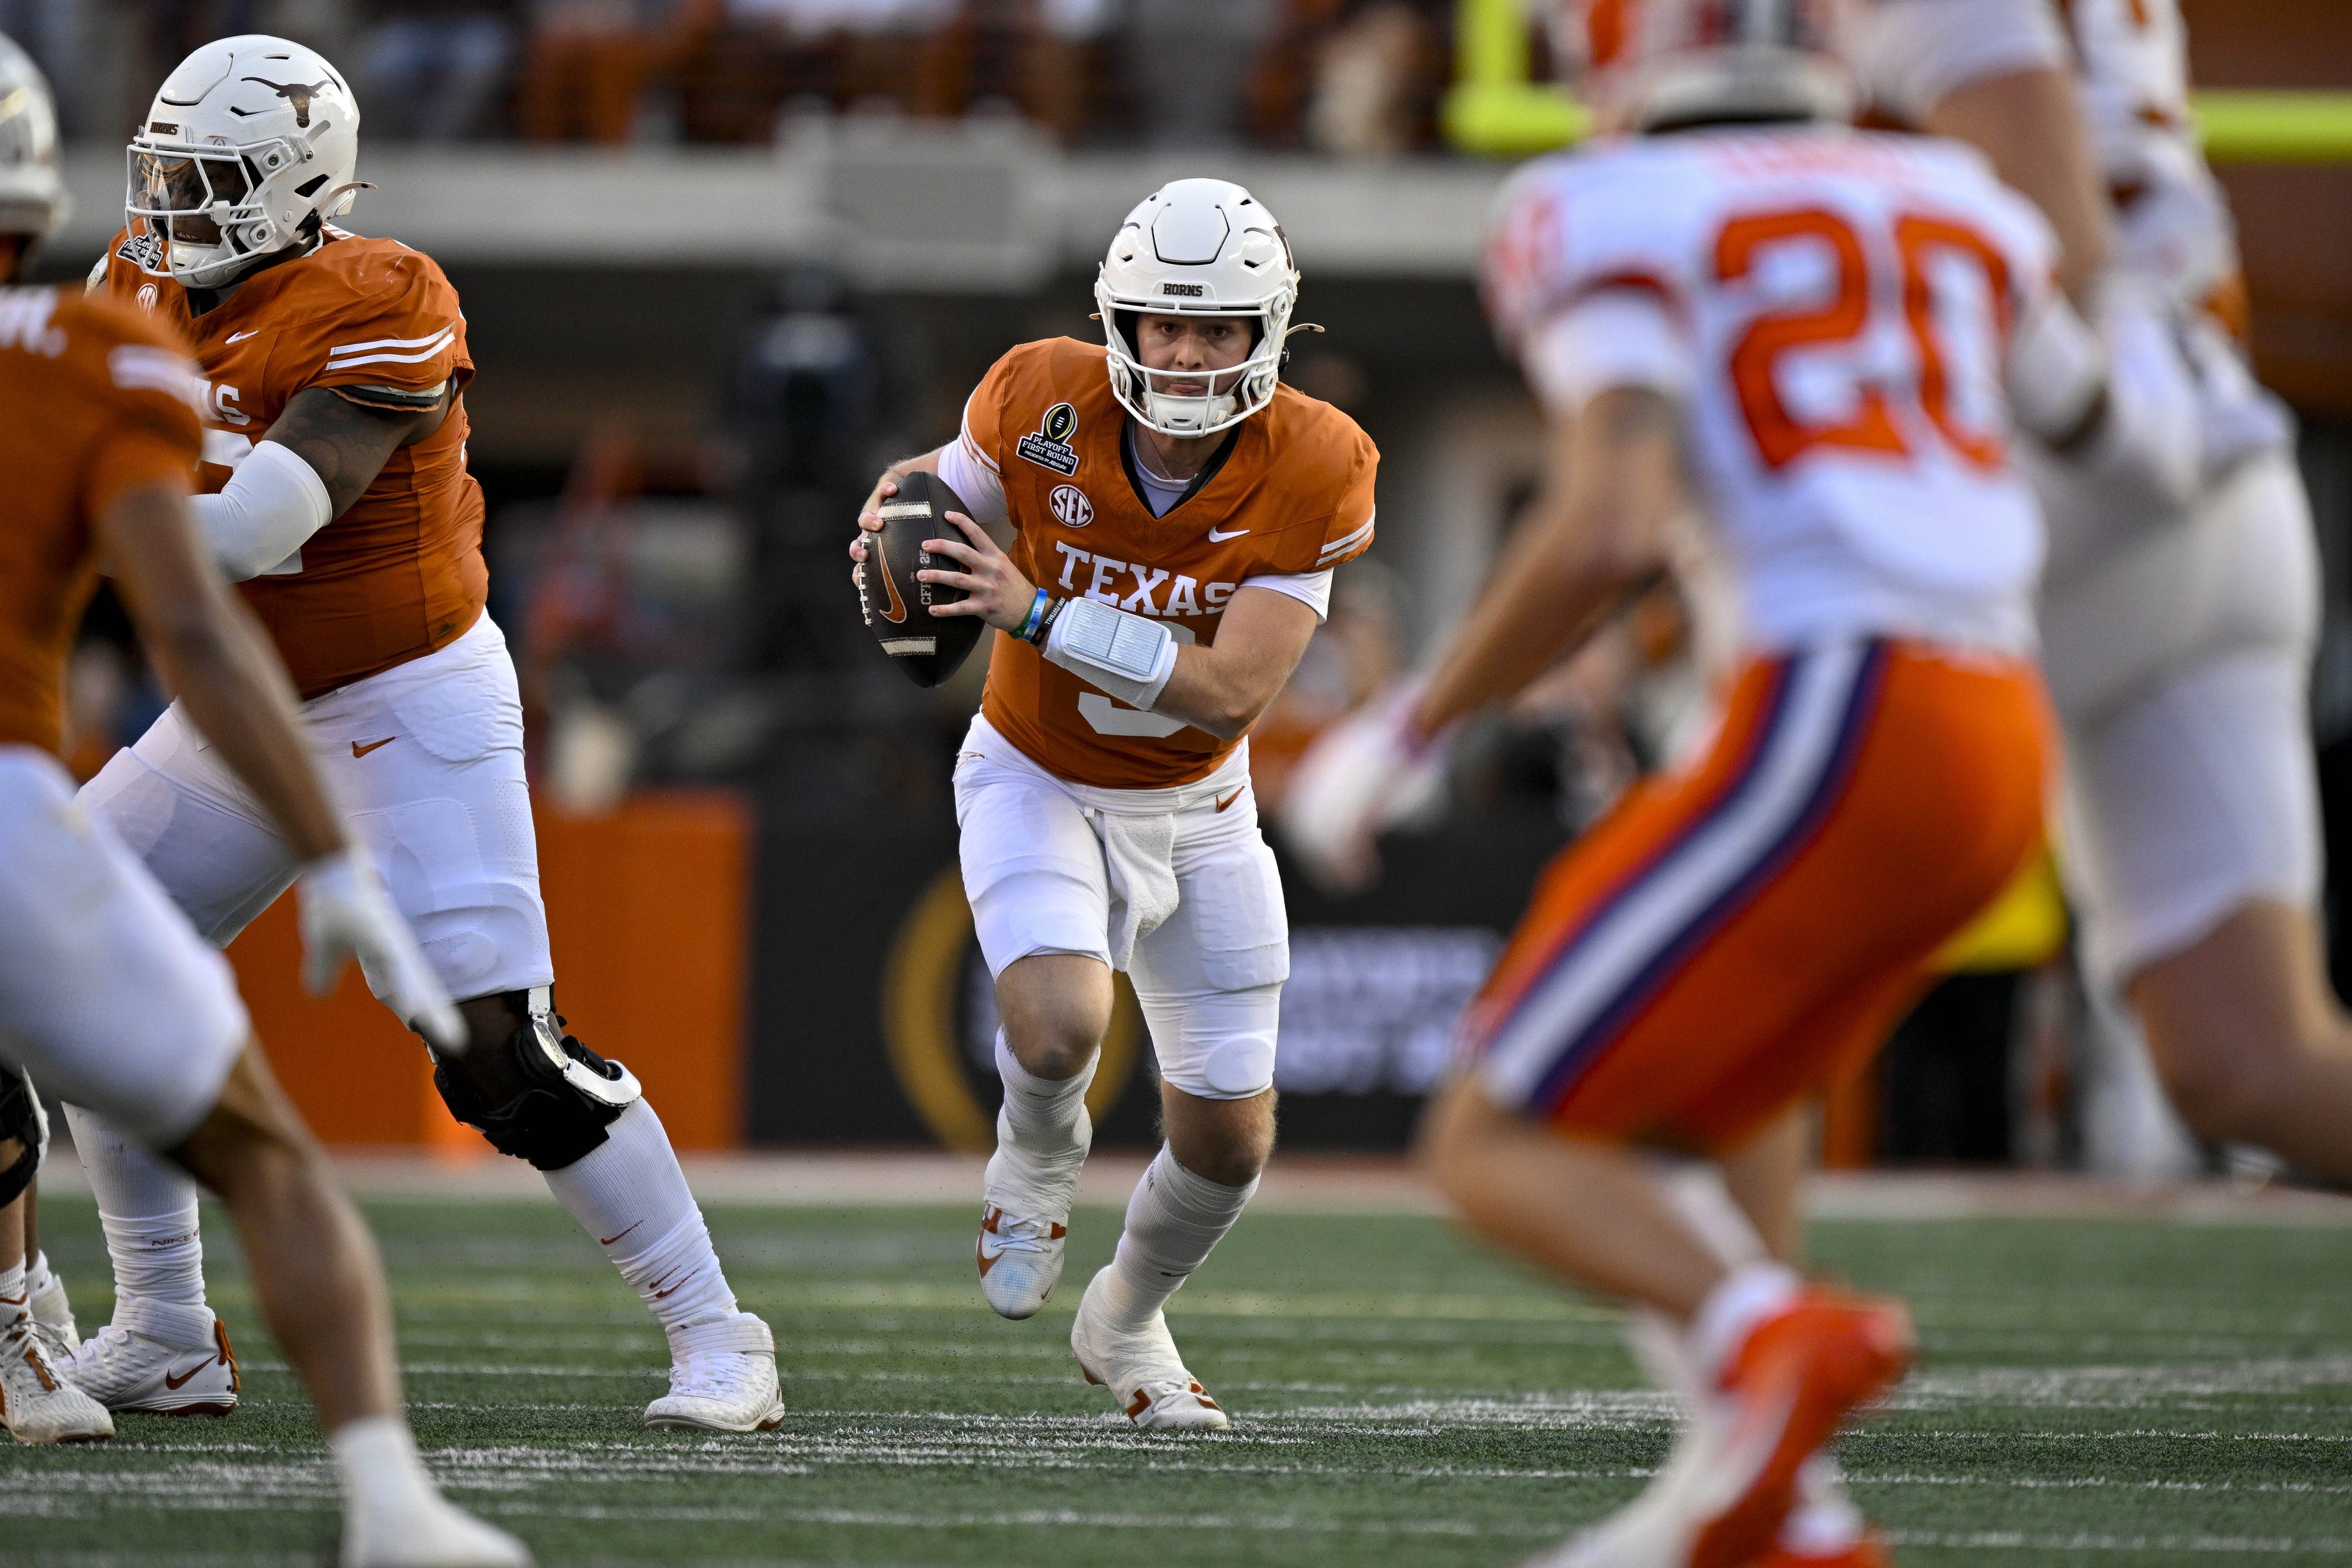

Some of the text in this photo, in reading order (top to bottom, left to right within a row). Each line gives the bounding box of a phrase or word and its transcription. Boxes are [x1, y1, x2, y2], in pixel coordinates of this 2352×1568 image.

[139, 248, 160, 261] ROND
[1163, 283, 1203, 296] HORNS
[1022, 440, 1074, 465] FIRST ROUND
[1033, 436, 1069, 454] PLAYOFF
[1053, 488, 1090, 525] SEC
[1056, 540, 1236, 616] TEXAS
[1044, 605, 1061, 625] FOOTBALL
